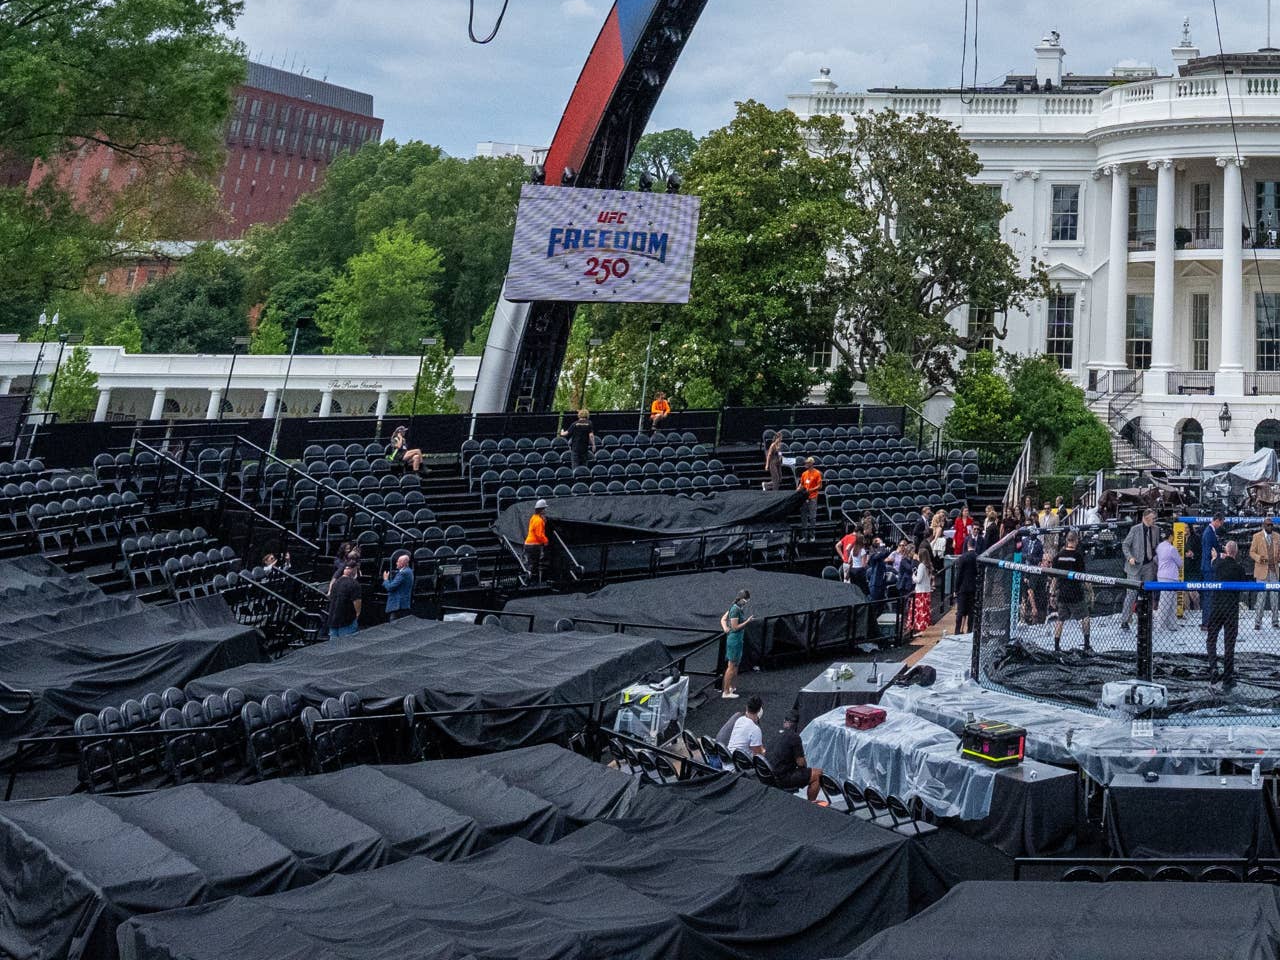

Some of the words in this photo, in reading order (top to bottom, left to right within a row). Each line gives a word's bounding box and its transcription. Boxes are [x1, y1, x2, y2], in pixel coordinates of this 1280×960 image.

[597, 211, 627, 224] UFC
[546, 228, 669, 264] FREEDOM
[583, 256, 630, 285] 250
